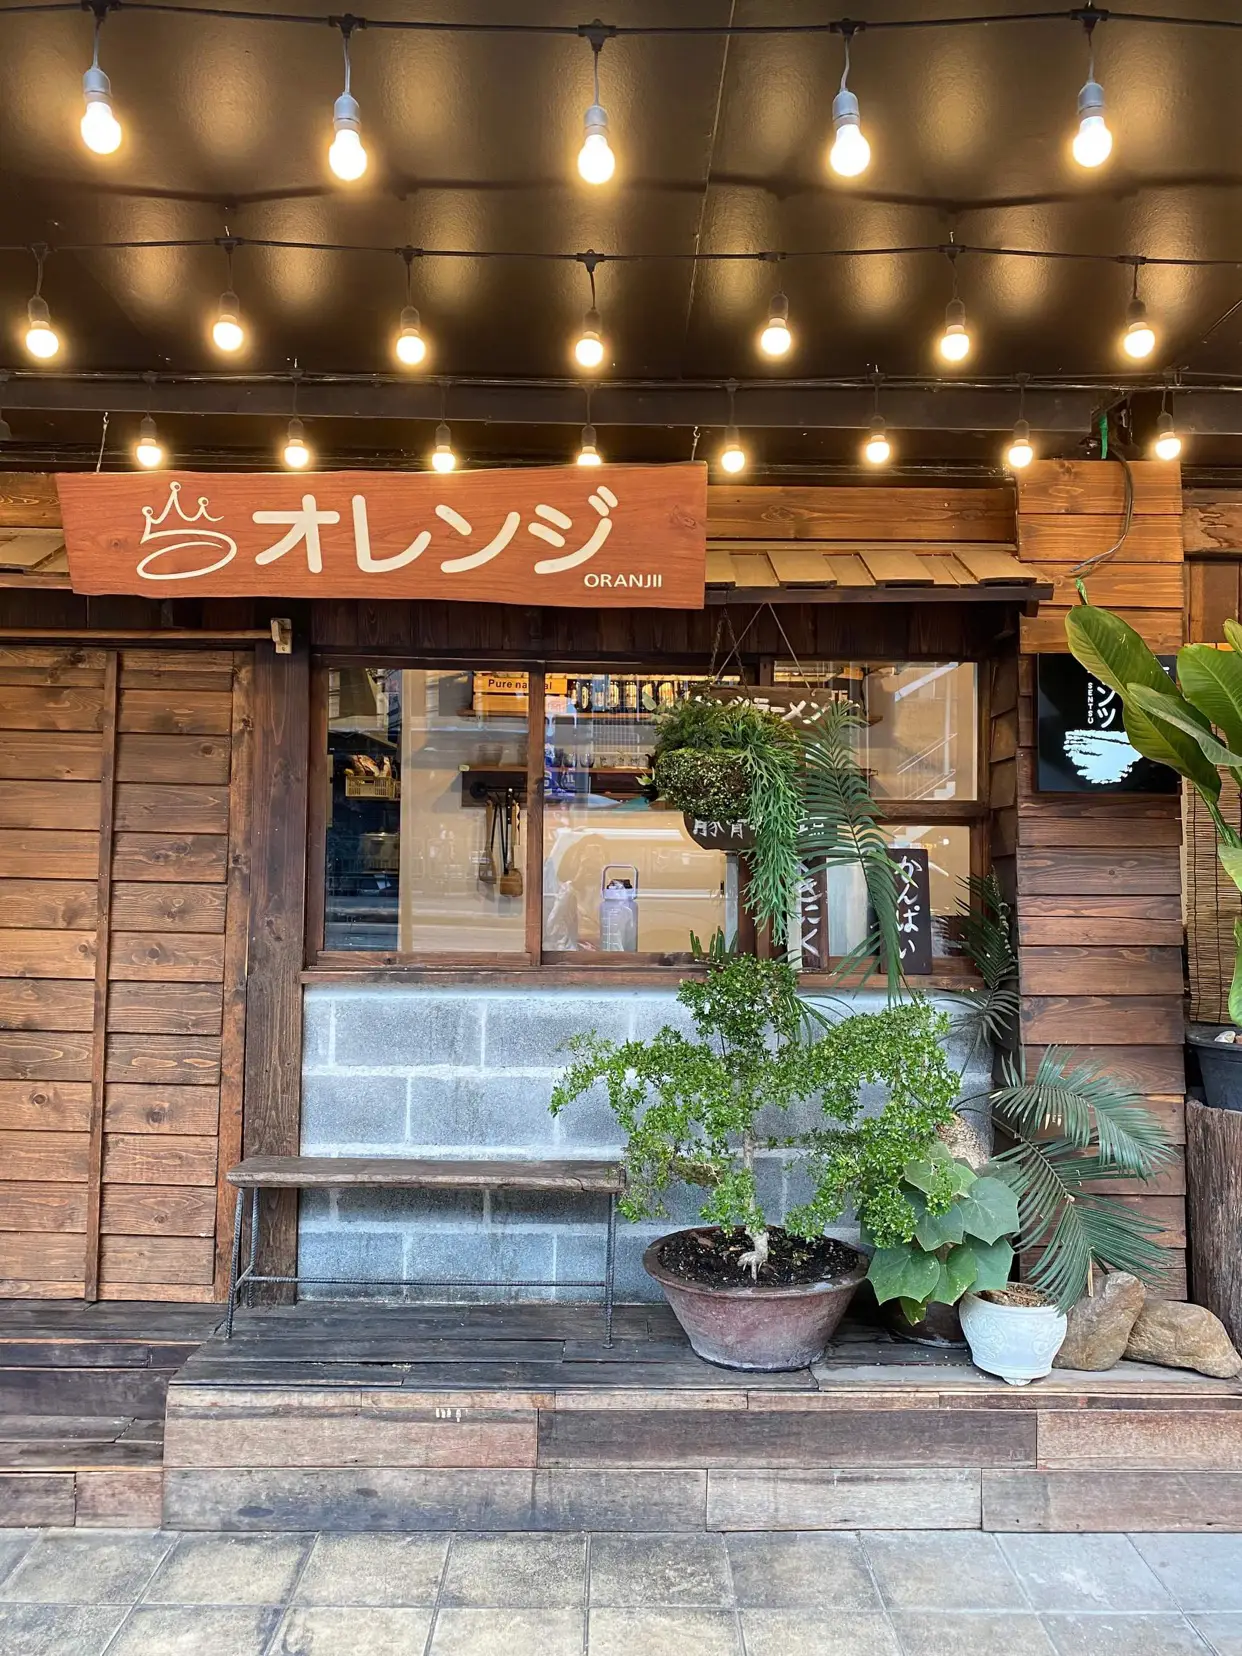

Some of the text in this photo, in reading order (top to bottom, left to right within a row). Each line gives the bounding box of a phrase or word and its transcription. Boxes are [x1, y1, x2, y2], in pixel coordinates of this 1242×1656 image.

[252, 485, 618, 573] オレンジ
[584, 573, 662, 588] ORANJII
[488, 679, 512, 689] Pure
[1097, 683, 1116, 728] ンツ
